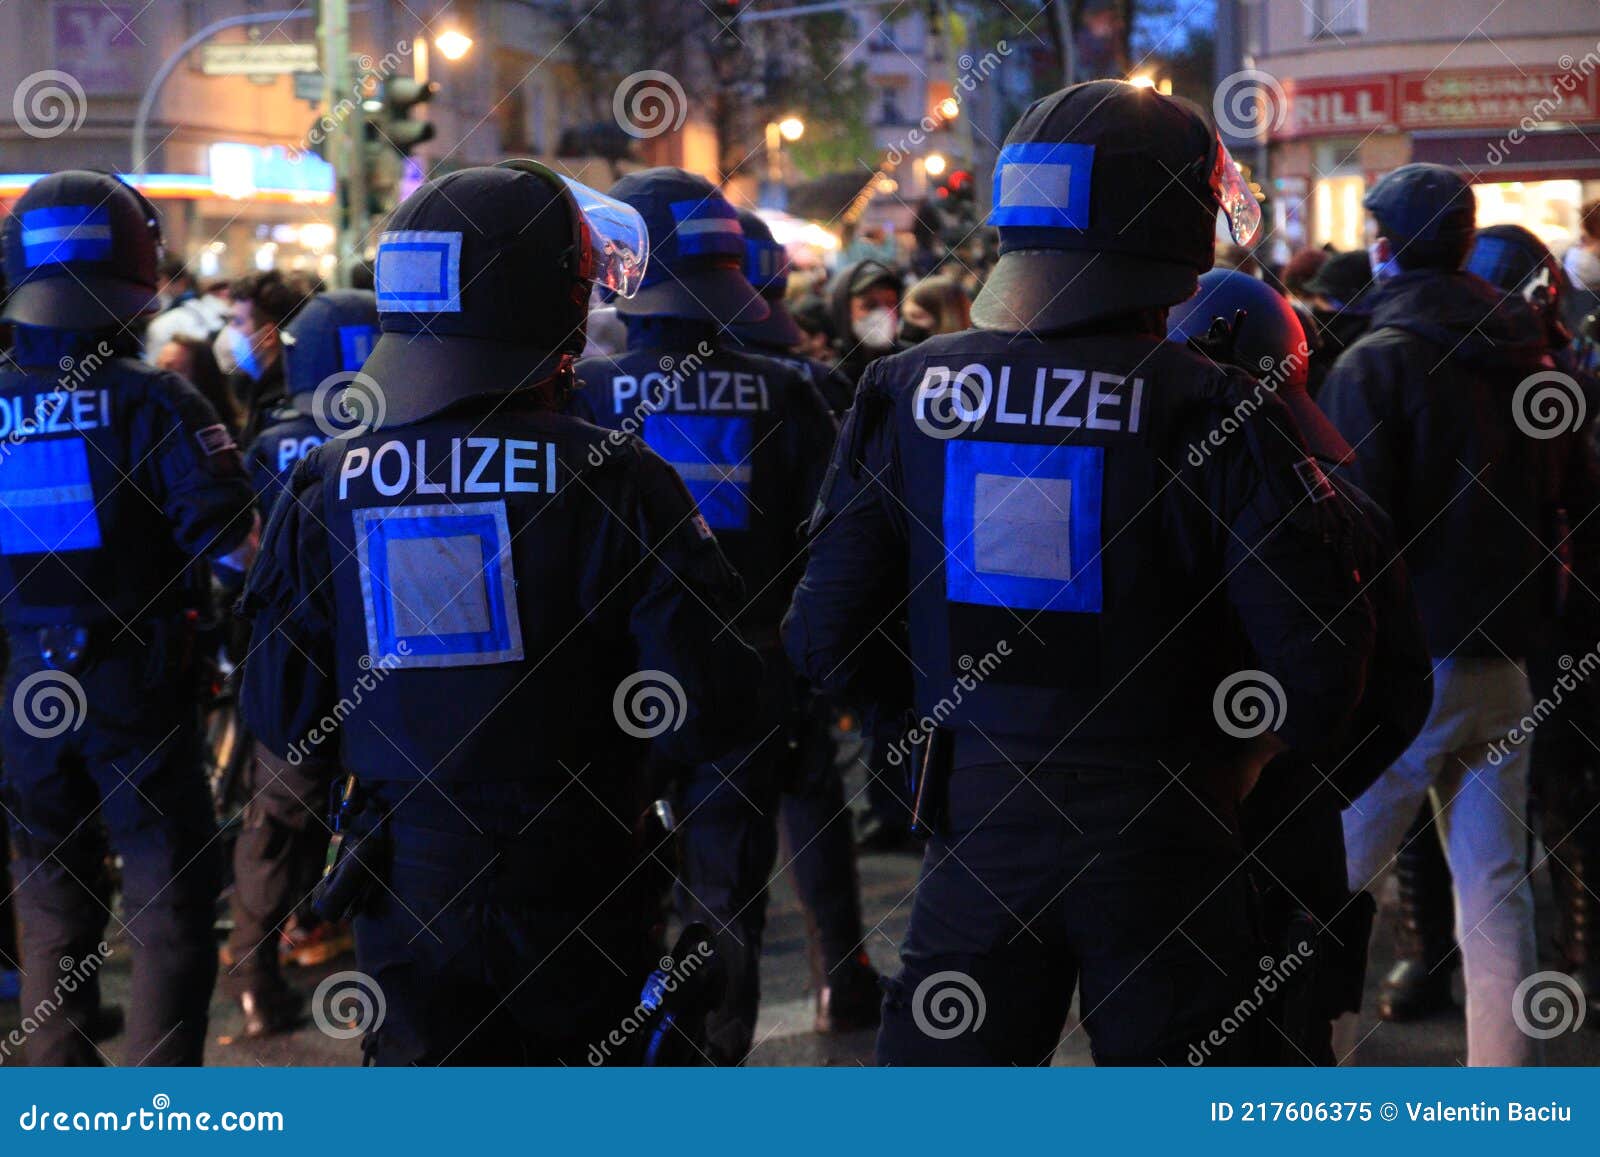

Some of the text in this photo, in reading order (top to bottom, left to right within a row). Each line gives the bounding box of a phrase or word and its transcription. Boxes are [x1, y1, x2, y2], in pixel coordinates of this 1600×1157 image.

[612, 371, 770, 415] POLIZEI
[915, 363, 1144, 433] POLIZEI
[338, 437, 558, 500] POLIZEI
